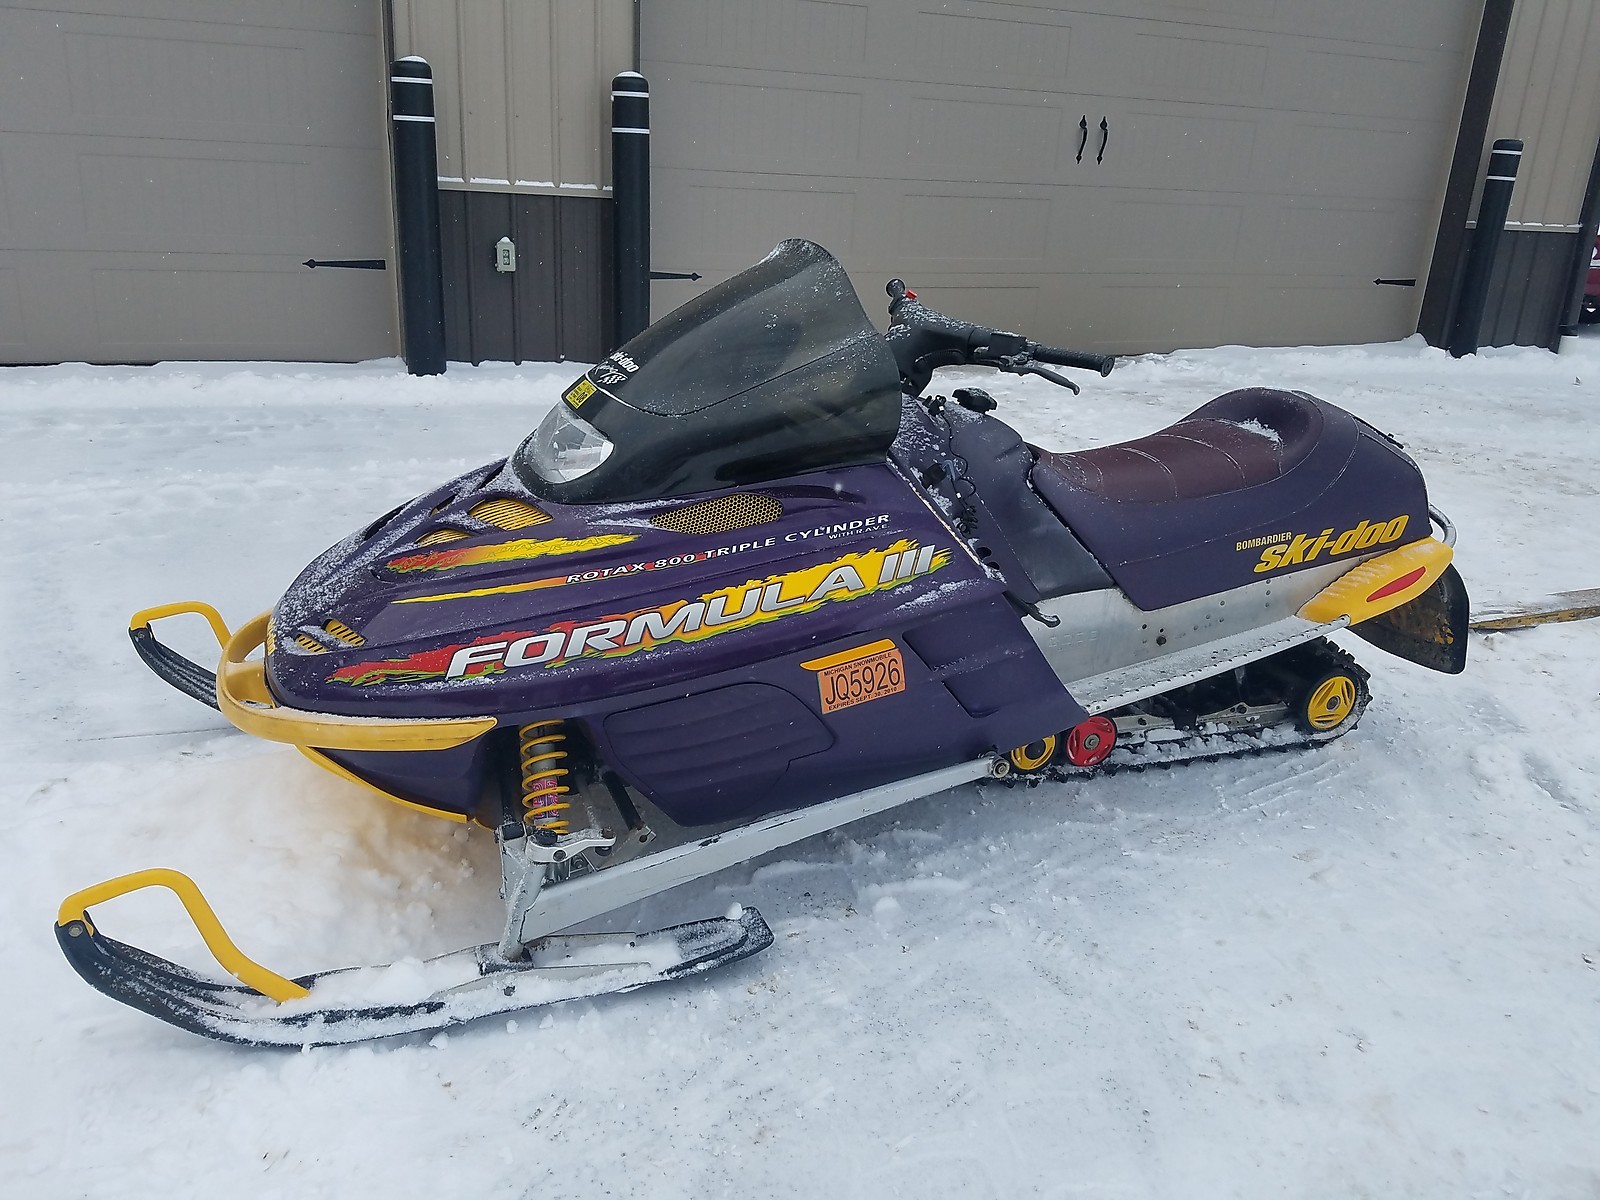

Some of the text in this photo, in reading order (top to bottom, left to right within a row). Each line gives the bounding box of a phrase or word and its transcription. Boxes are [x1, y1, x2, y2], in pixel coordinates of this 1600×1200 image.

[828, 530, 854, 540] WITH
[1235, 531, 1292, 551] BOMBARDIER
[566, 514, 890, 584] ROTAX 800 TRIPLE CYLINDER
[445, 544, 937, 679] FORMULA III
[823, 652, 892, 677] MICHIGAN SNOWMOBILE
[825, 658, 901, 705] JQ5926
[828, 698, 855, 711] EXPIRES
[855, 693, 874, 703] SEPT.
